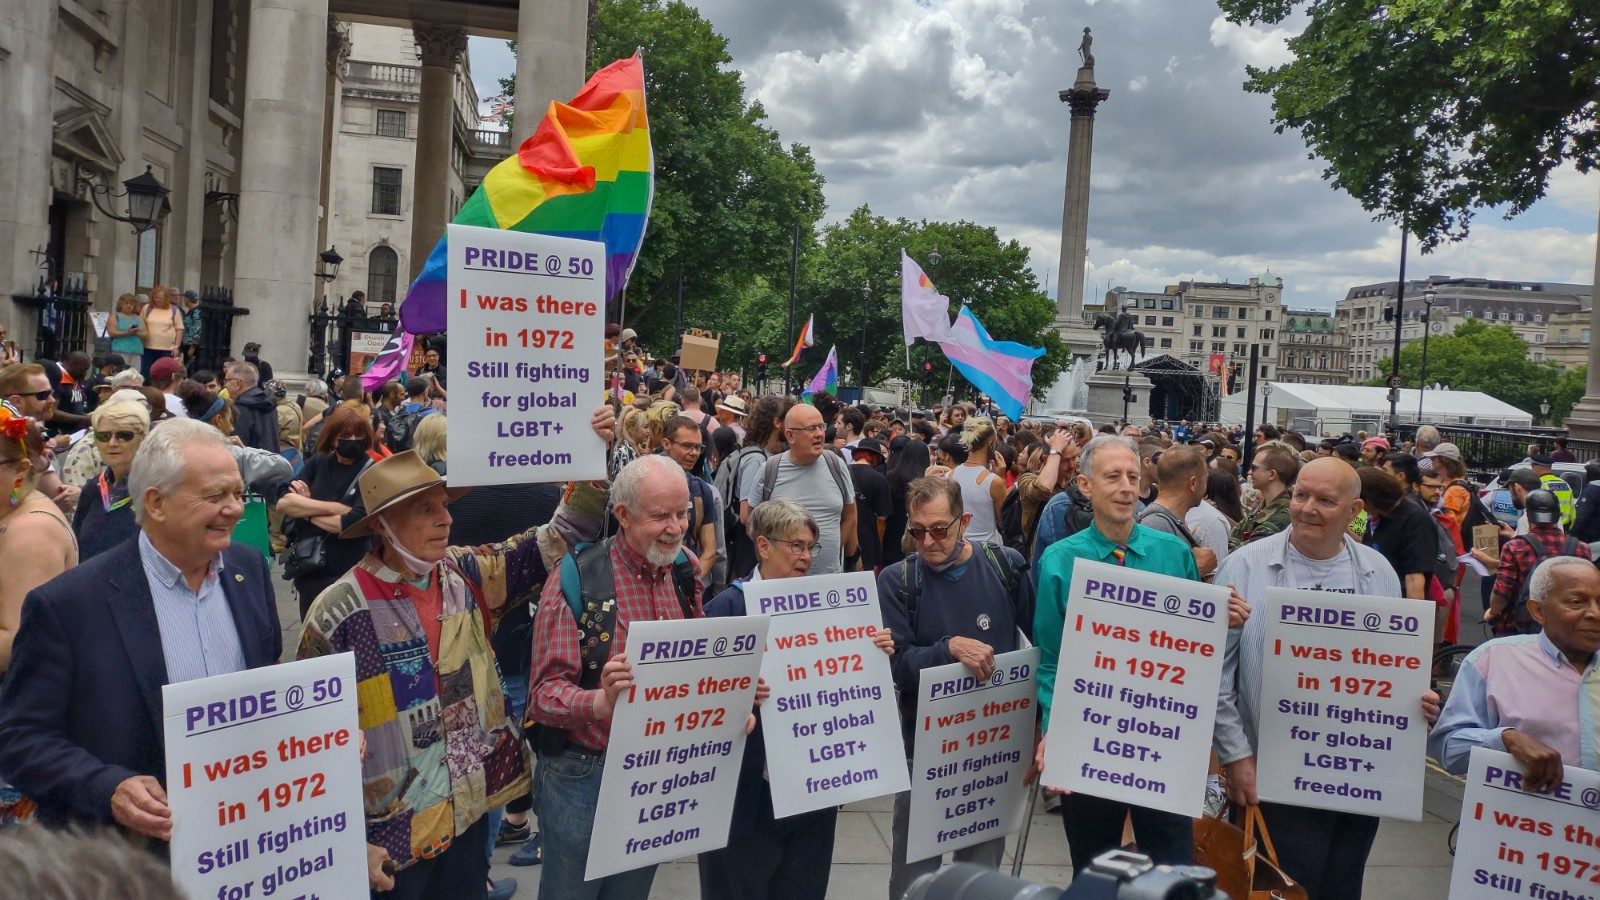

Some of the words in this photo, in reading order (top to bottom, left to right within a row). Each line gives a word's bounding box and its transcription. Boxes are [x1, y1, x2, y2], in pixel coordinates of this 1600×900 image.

[465, 247, 538, 271] PRIDE
[545, 255, 561, 274] @
[568, 258, 593, 275] 50
[460, 289, 467, 308] I
[477, 295, 527, 312] was
[536, 295, 597, 316] there
[486, 328, 507, 346] in
[517, 329, 574, 349] 1972
[468, 362, 509, 378] Still
[516, 363, 589, 383] fighting
[482, 392, 510, 407] for
[517, 392, 576, 411] global
[498, 421, 563, 437] LGBT+
[489, 450, 571, 466] freedom
[760, 592, 821, 614] PRIDE
[826, 590, 840, 608] @
[846, 587, 867, 604] 50
[1085, 579, 1158, 608] PRIDE
[1163, 595, 1181, 614] @
[1187, 599, 1216, 618] 50
[1281, 605, 1356, 627] PRIDE
[1363, 613, 1381, 631] @
[1389, 615, 1419, 632] 50
[640, 638, 708, 660] PRIDE
[713, 637, 728, 657] @
[732, 634, 756, 653] 50
[775, 632, 818, 650] was
[824, 624, 876, 643] there
[1075, 615, 1083, 631] I
[1092, 621, 1140, 643] was
[1149, 629, 1215, 657] there
[787, 664, 807, 682] in
[814, 654, 863, 677] 1972
[1094, 651, 1115, 671] in
[1126, 657, 1185, 685] 1972
[1274, 639, 1281, 655] I
[1290, 644, 1342, 662] was
[1352, 648, 1421, 669] there
[992, 670, 1004, 686] @
[1010, 664, 1030, 680] 50
[1298, 673, 1320, 690] in
[1330, 676, 1392, 698] 1972
[186, 690, 277, 731] PRIDE
[285, 685, 304, 710] @
[312, 676, 342, 701] 50
[628, 684, 636, 703] I
[644, 684, 689, 702] was
[697, 677, 751, 696] there
[776, 693, 811, 712] Still
[817, 684, 881, 707] fighting
[1073, 678, 1113, 699] Still
[1120, 688, 1198, 719] fighting
[645, 718, 665, 737] in
[675, 708, 725, 732] 1972
[792, 723, 817, 738] for
[823, 710, 875, 736] global
[924, 716, 930, 731] I
[937, 709, 976, 728] was
[983, 698, 1030, 718] there
[1082, 708, 1111, 726] for
[1117, 716, 1180, 741] global
[1278, 699, 1319, 716] Still
[1326, 704, 1409, 730] fighting
[809, 740, 866, 763] LGBT+
[941, 739, 958, 755] in
[966, 724, 1010, 748] 1972
[1093, 737, 1162, 763] LGBT+
[1290, 726, 1320, 742] for
[1326, 732, 1392, 750] global
[183, 763, 191, 788] I
[204, 750, 268, 782] was
[277, 728, 349, 762] there
[623, 750, 660, 770] Still
[666, 740, 732, 764] fighting
[926, 762, 957, 781] Still
[963, 750, 1021, 772] fighting
[1304, 753, 1375, 773] LGBT+
[630, 781, 657, 797] for
[662, 767, 716, 794] global
[805, 767, 878, 793] freedom
[935, 787, 957, 801] for
[963, 771, 1008, 797] global
[1080, 763, 1166, 794] freedom
[1294, 777, 1382, 801] freedom
[1485, 766, 1572, 800] PRE
[1581, 788, 1600, 808] @
[218, 802, 245, 826] in
[257, 772, 326, 813] 1972
[638, 799, 699, 824] LGBT+
[945, 797, 995, 820] LGBT+
[937, 816, 1000, 843] freedom
[1474, 802, 1483, 820] I
[1494, 810, 1553, 836] was
[197, 839, 249, 874] Still
[257, 811, 346, 854] fighting
[626, 827, 700, 854] freedom
[1498, 842, 1524, 864] in
[218, 880, 254, 900] for
[262, 847, 333, 896] global
[1474, 868, 1521, 893] Still
